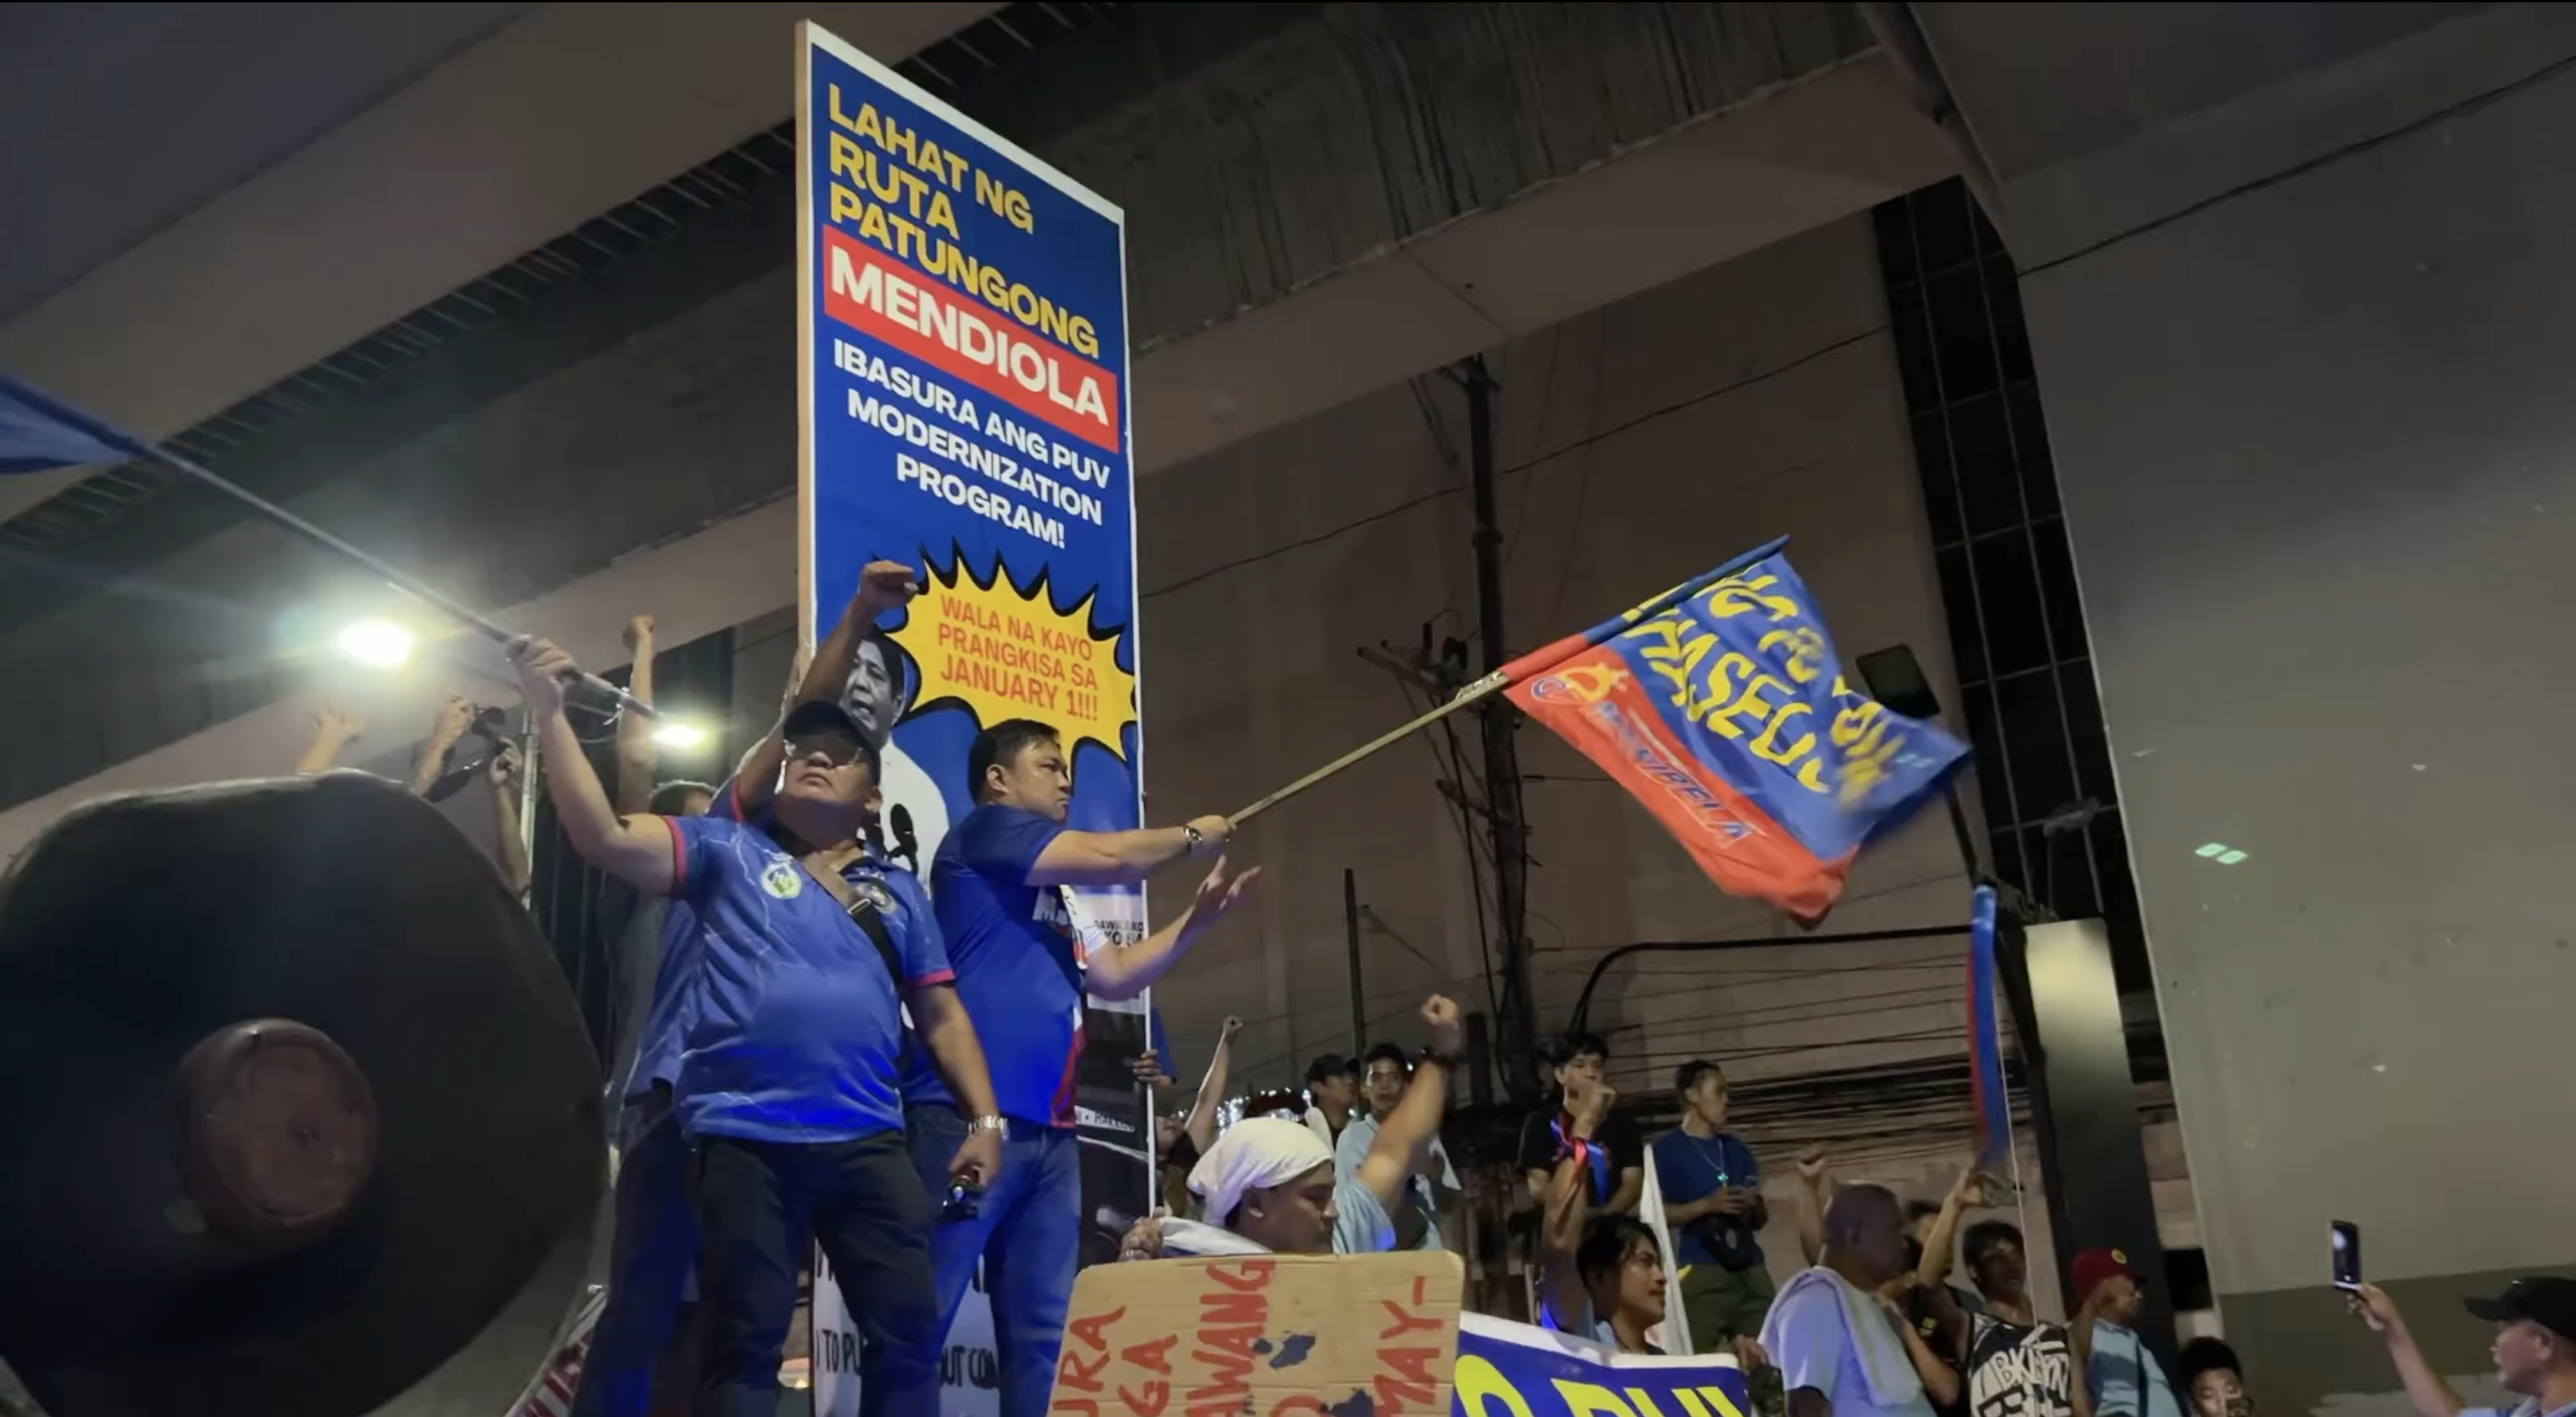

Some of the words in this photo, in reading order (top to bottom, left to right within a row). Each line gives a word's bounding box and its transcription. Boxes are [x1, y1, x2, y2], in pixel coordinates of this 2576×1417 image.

[829, 83, 968, 193] LAHAT
[975, 168, 1033, 235] NG
[830, 130, 961, 241] RUTA
[830, 181, 1099, 360] PATUNGONG
[831, 244, 1109, 427] MENDIOLA
[833, 338, 980, 432] IBASURA
[984, 413, 1049, 465] ANG
[1053, 442, 1111, 490] PUV
[847, 388, 1103, 527] MODERNIZATION
[896, 452, 1066, 550] PROGRAM!
[938, 622, 1066, 681] PRANGKISA
[1070, 662, 1099, 691] SA
[940, 592, 1001, 633] WALA
[1007, 615, 1036, 643] NA
[1041, 626, 1092, 661] KAYO
[940, 653, 1058, 711] JANUARY
[1066, 689, 1099, 722] 1!!!
